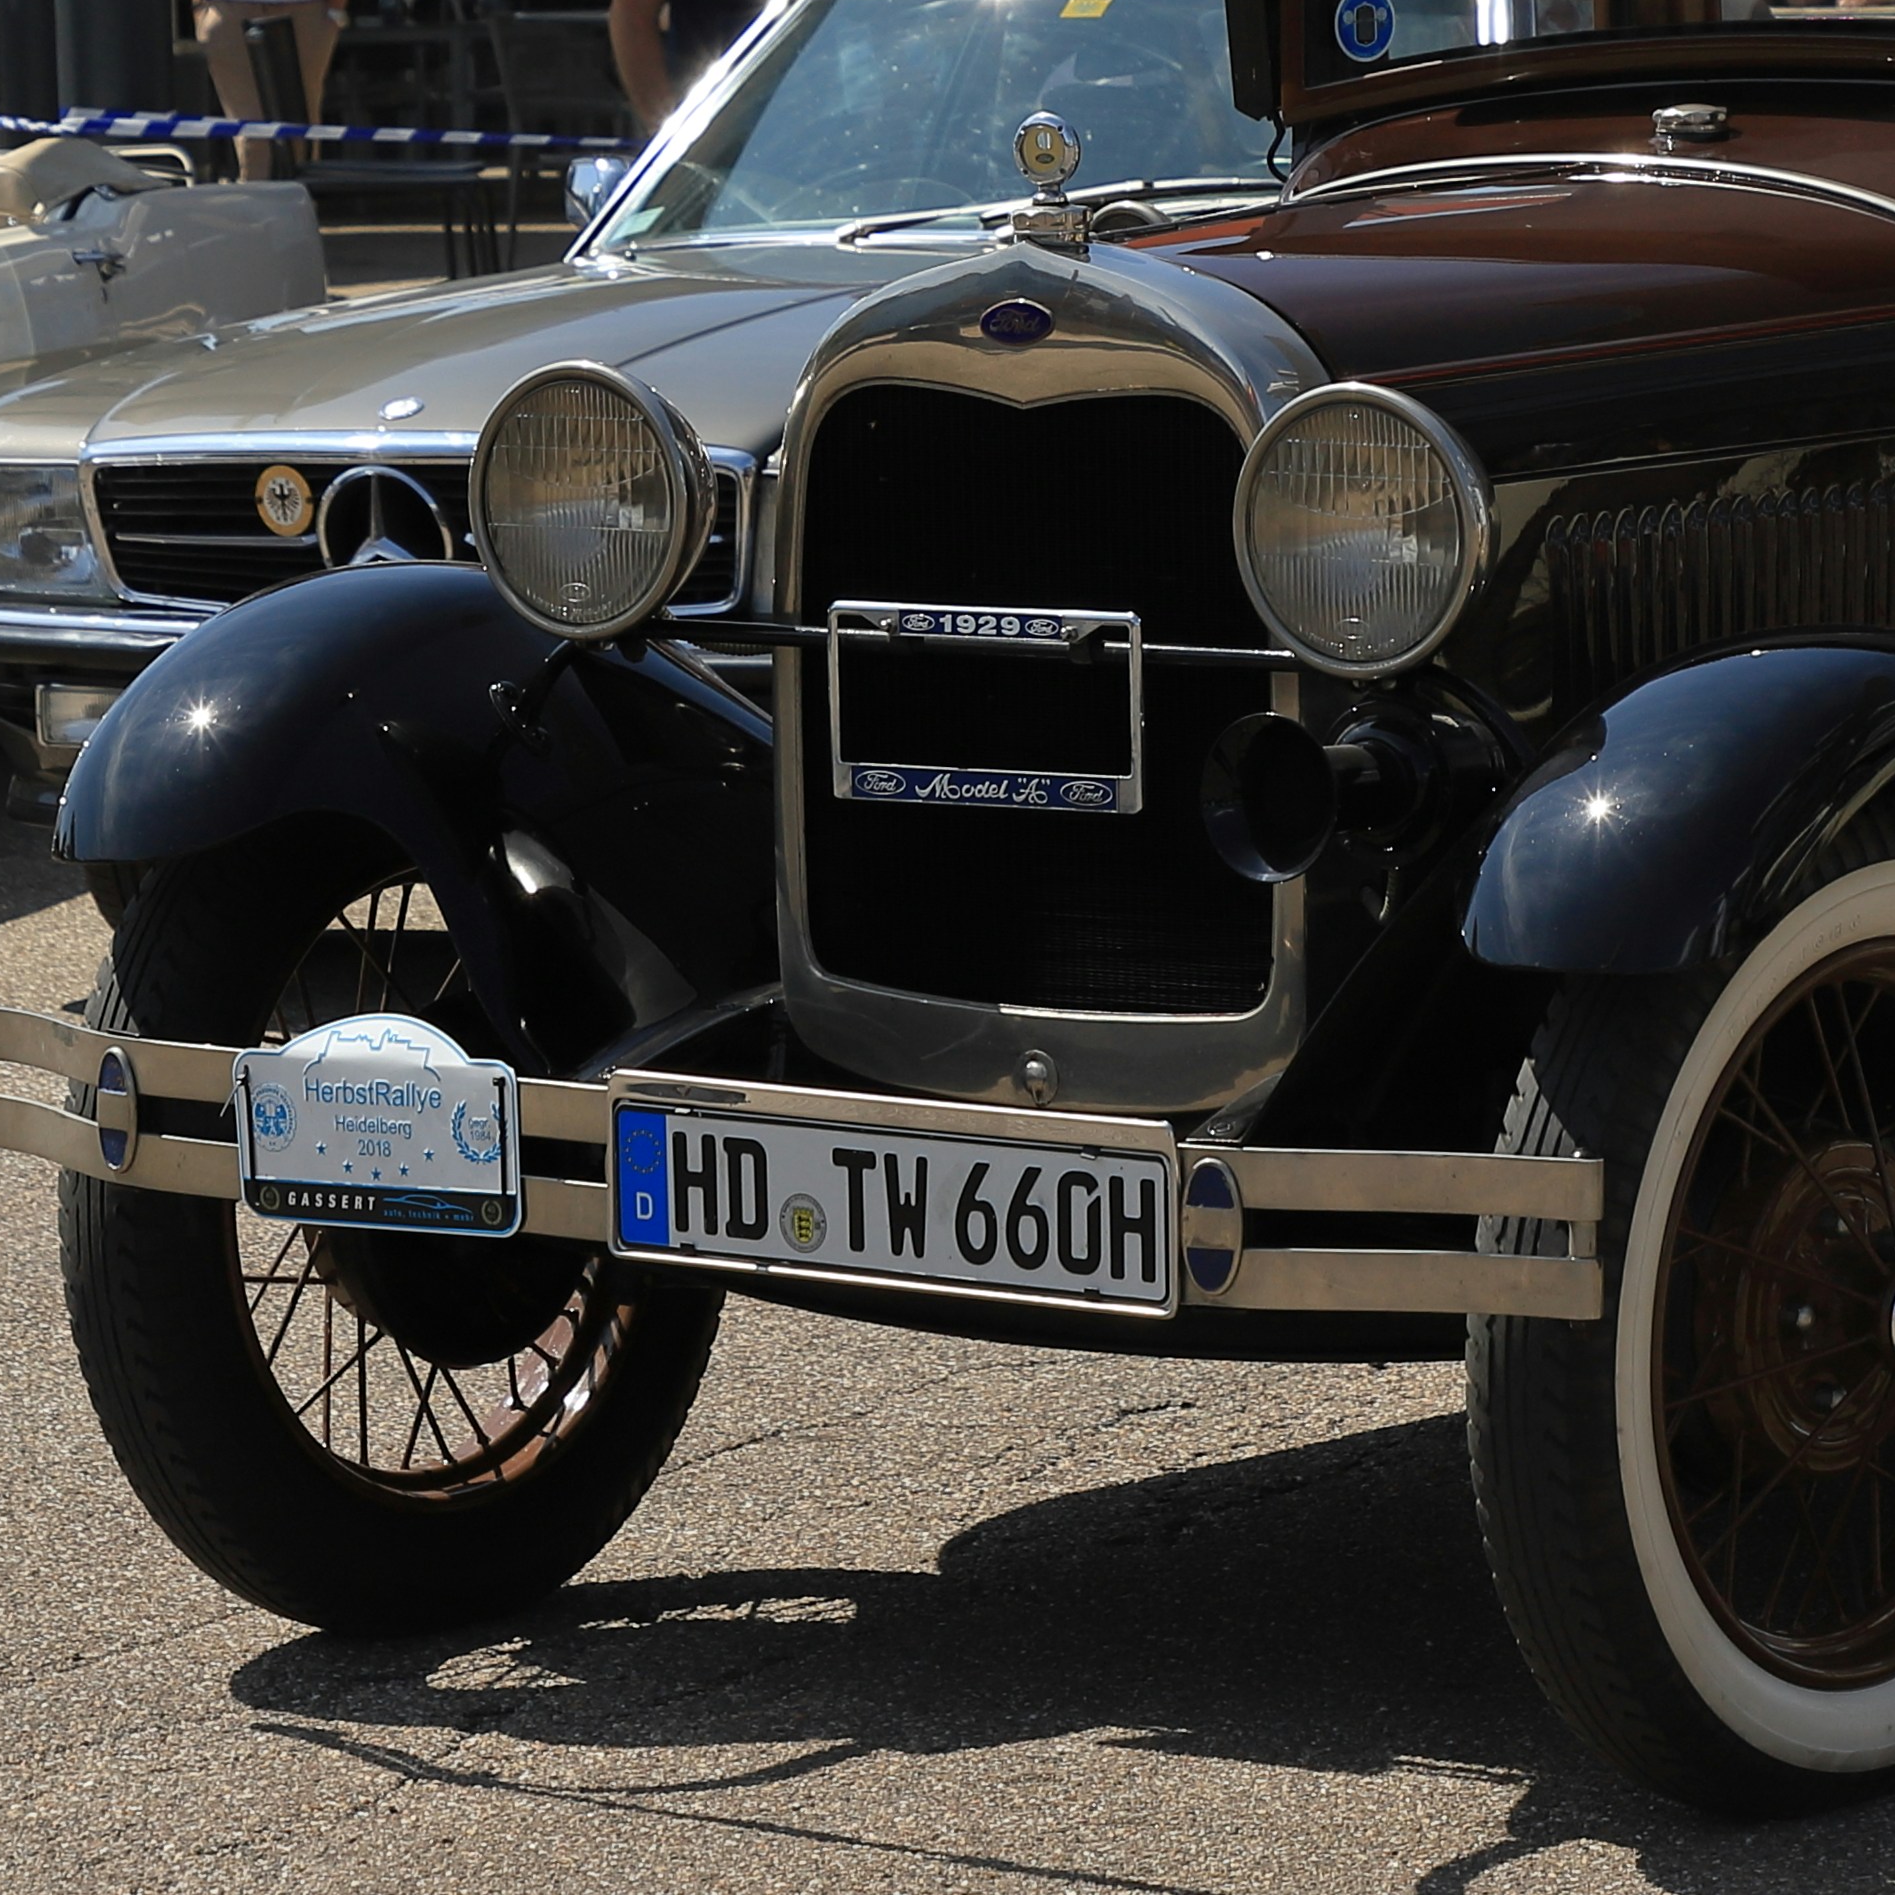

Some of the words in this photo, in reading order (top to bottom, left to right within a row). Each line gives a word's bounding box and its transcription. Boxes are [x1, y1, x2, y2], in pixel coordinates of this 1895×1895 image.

[990, 308, 1041, 334] Ford
[939, 614, 1021, 636] 1929
[1030, 621, 1054, 636] Ford
[864, 773, 897, 793] Ford
[915, 774, 1009, 800] Model
[1069, 784, 1103, 804] Ford
[303, 1077, 443, 1115] HerbstRallye
[334, 1115, 413, 1139] Heidelberg
[358, 1139, 392, 1159] 2018
[287, 1190, 377, 1212] GASSERT
[635, 1191, 654, 1222] D
[671, 1131, 769, 1242] HD
[831, 1147, 929, 1260] TW
[955, 1161, 1158, 1284] 660H
